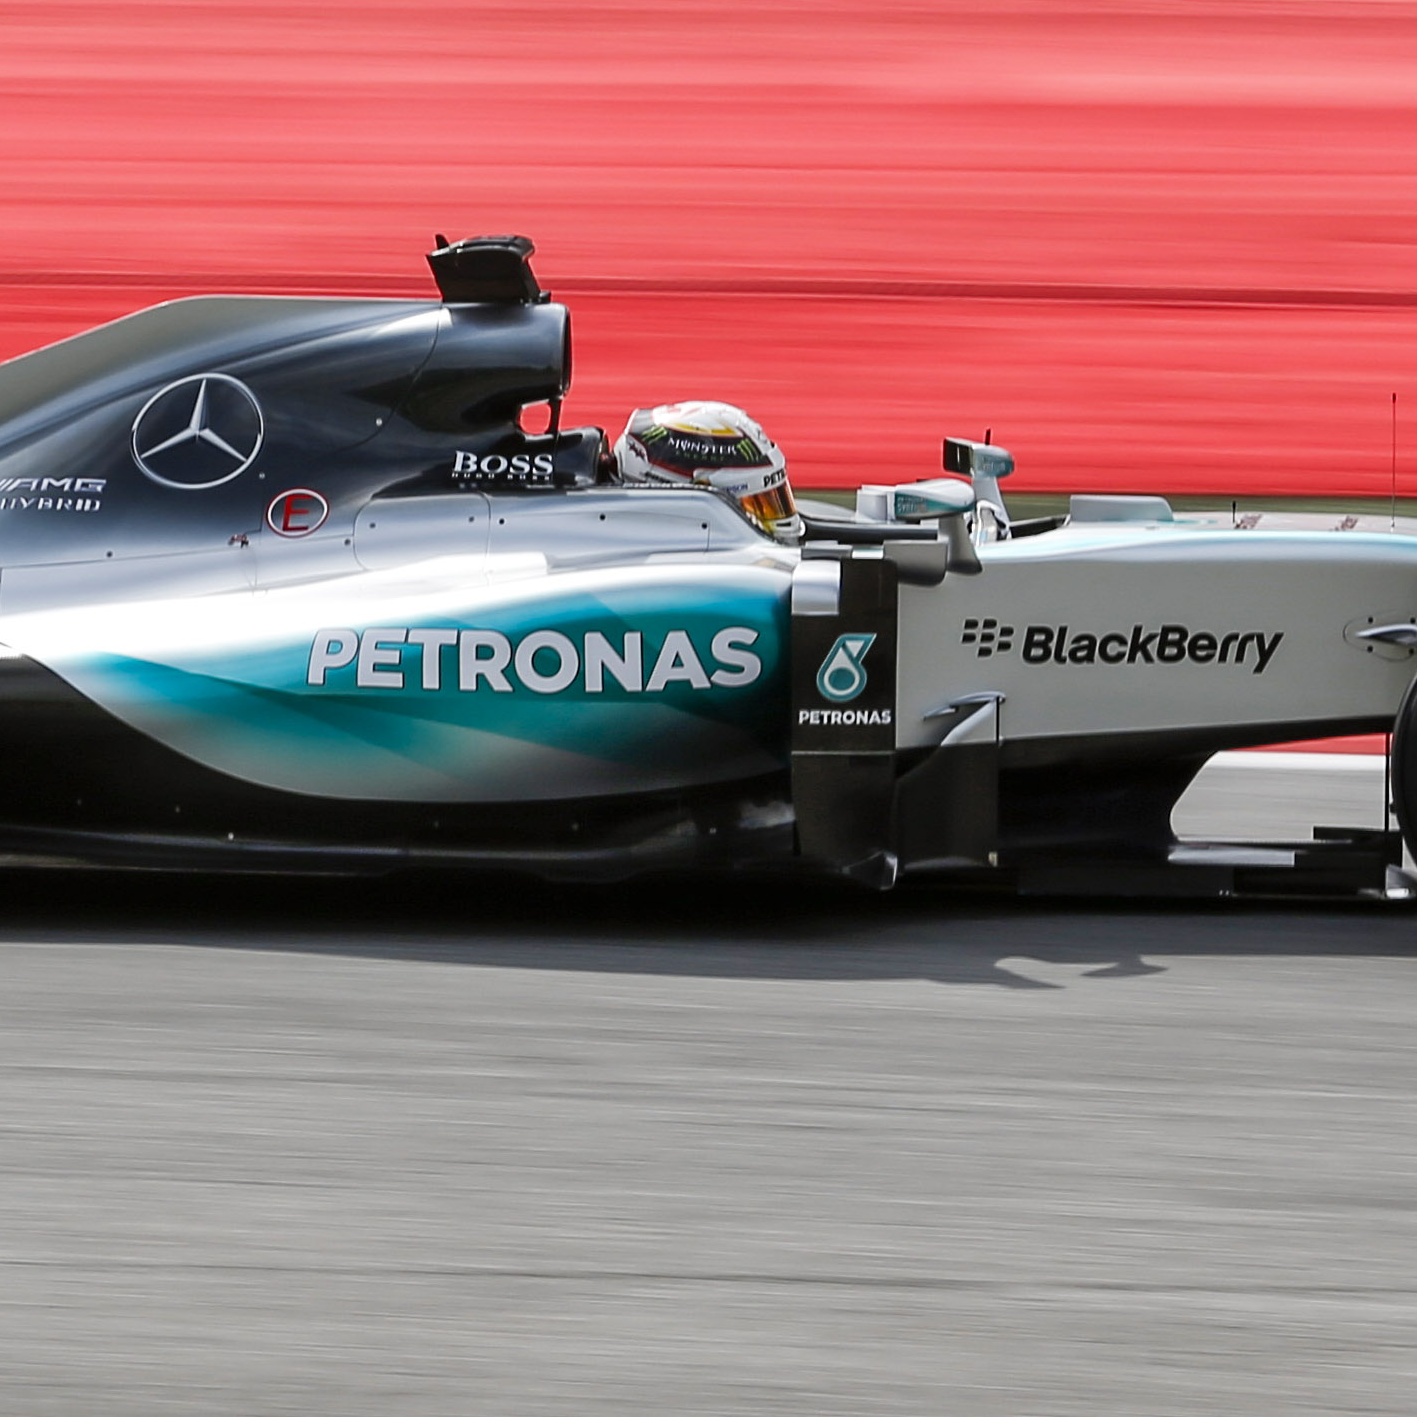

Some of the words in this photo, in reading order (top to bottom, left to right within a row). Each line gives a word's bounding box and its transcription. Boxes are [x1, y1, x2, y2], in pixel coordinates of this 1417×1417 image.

[667, 436, 738, 457] MONSTER
[453, 450, 554, 476] BOSS
[6, 477, 108, 494] AMG
[0, 496, 102, 512] HYBRID
[282, 493, 313, 532] E
[306, 625, 763, 695] PETRONAS
[1021, 624, 1285, 675] BlackBerry
[797, 708, 892, 726] PETRONAS
